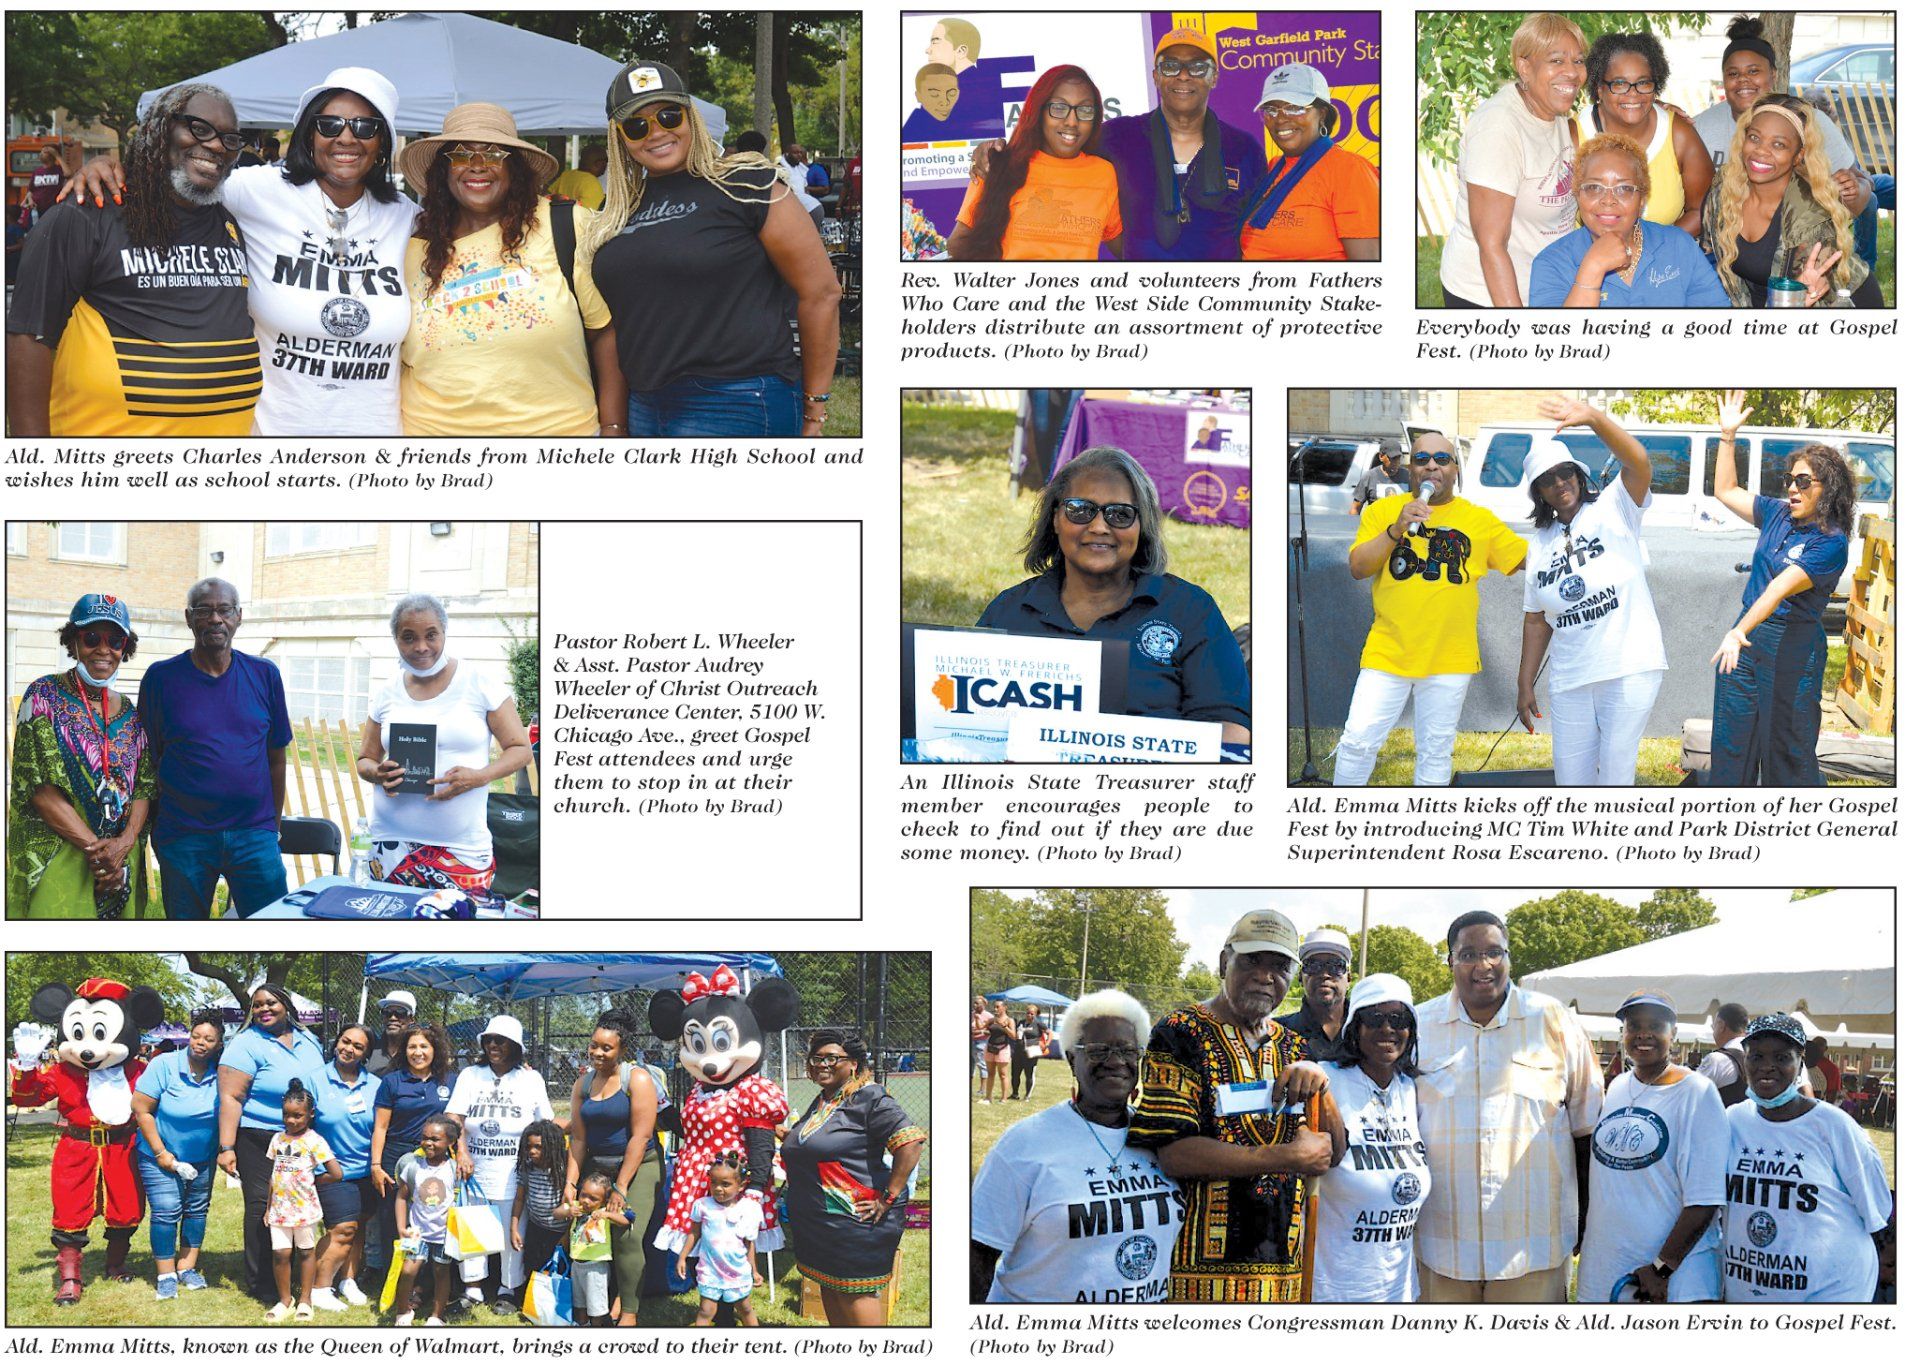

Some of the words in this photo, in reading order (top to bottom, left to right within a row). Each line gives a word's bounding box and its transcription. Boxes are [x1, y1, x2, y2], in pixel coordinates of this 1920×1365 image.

[1218, 36, 1252, 48] West
[1255, 31, 1311, 46] Garfield
[1314, 28, 1347, 41] Park
[1220, 42, 1347, 71] Community
[903, 155, 955, 166] romoting
[903, 166, 918, 177] nd
[120, 245, 214, 276] MICHELE
[300, 241, 379, 267] EMMA
[137, 275, 151, 288] ES
[152, 275, 167, 288] UN
[168, 275, 190, 287] BUEN
[202, 274, 221, 287] PARA
[220, 275, 233, 287] SER
[272, 254, 403, 297] MITTS
[276, 332, 398, 359] ALDERMAN
[272, 348, 326, 377] 37TH
[331, 361, 390, 380] WARD
[88, 604, 123, 618] JESUS
[1556, 612, 1582, 628] 37TH
[1582, 597, 1619, 622] WARD
[935, 655, 990, 666] ILLINOIS
[997, 659, 1071, 672] TREASURER
[935, 664, 992, 676] MICHAEL
[1000, 668, 1012, 677] W.
[1020, 670, 1083, 682] FRERICHS
[398, 736, 412, 744] Holy
[1039, 728, 1125, 748] ILLINOIS
[1132, 736, 1198, 755] STATE
[466, 1104, 522, 1118] MITTS
[1362, 1128, 1412, 1142] EMMA
[488, 1147, 517, 1157] WARD
[1351, 1141, 1427, 1171] MITTS
[1736, 1158, 1804, 1179] EMMA
[1088, 1174, 1170, 1196] EMMA
[1726, 1172, 1819, 1213] MITTS
[1068, 1189, 1187, 1239] MITTS
[1352, 1226, 1392, 1243] 37TH
[1075, 1277, 1169, 1303] ALDERMA
[1755, 1270, 1808, 1290] WARD
